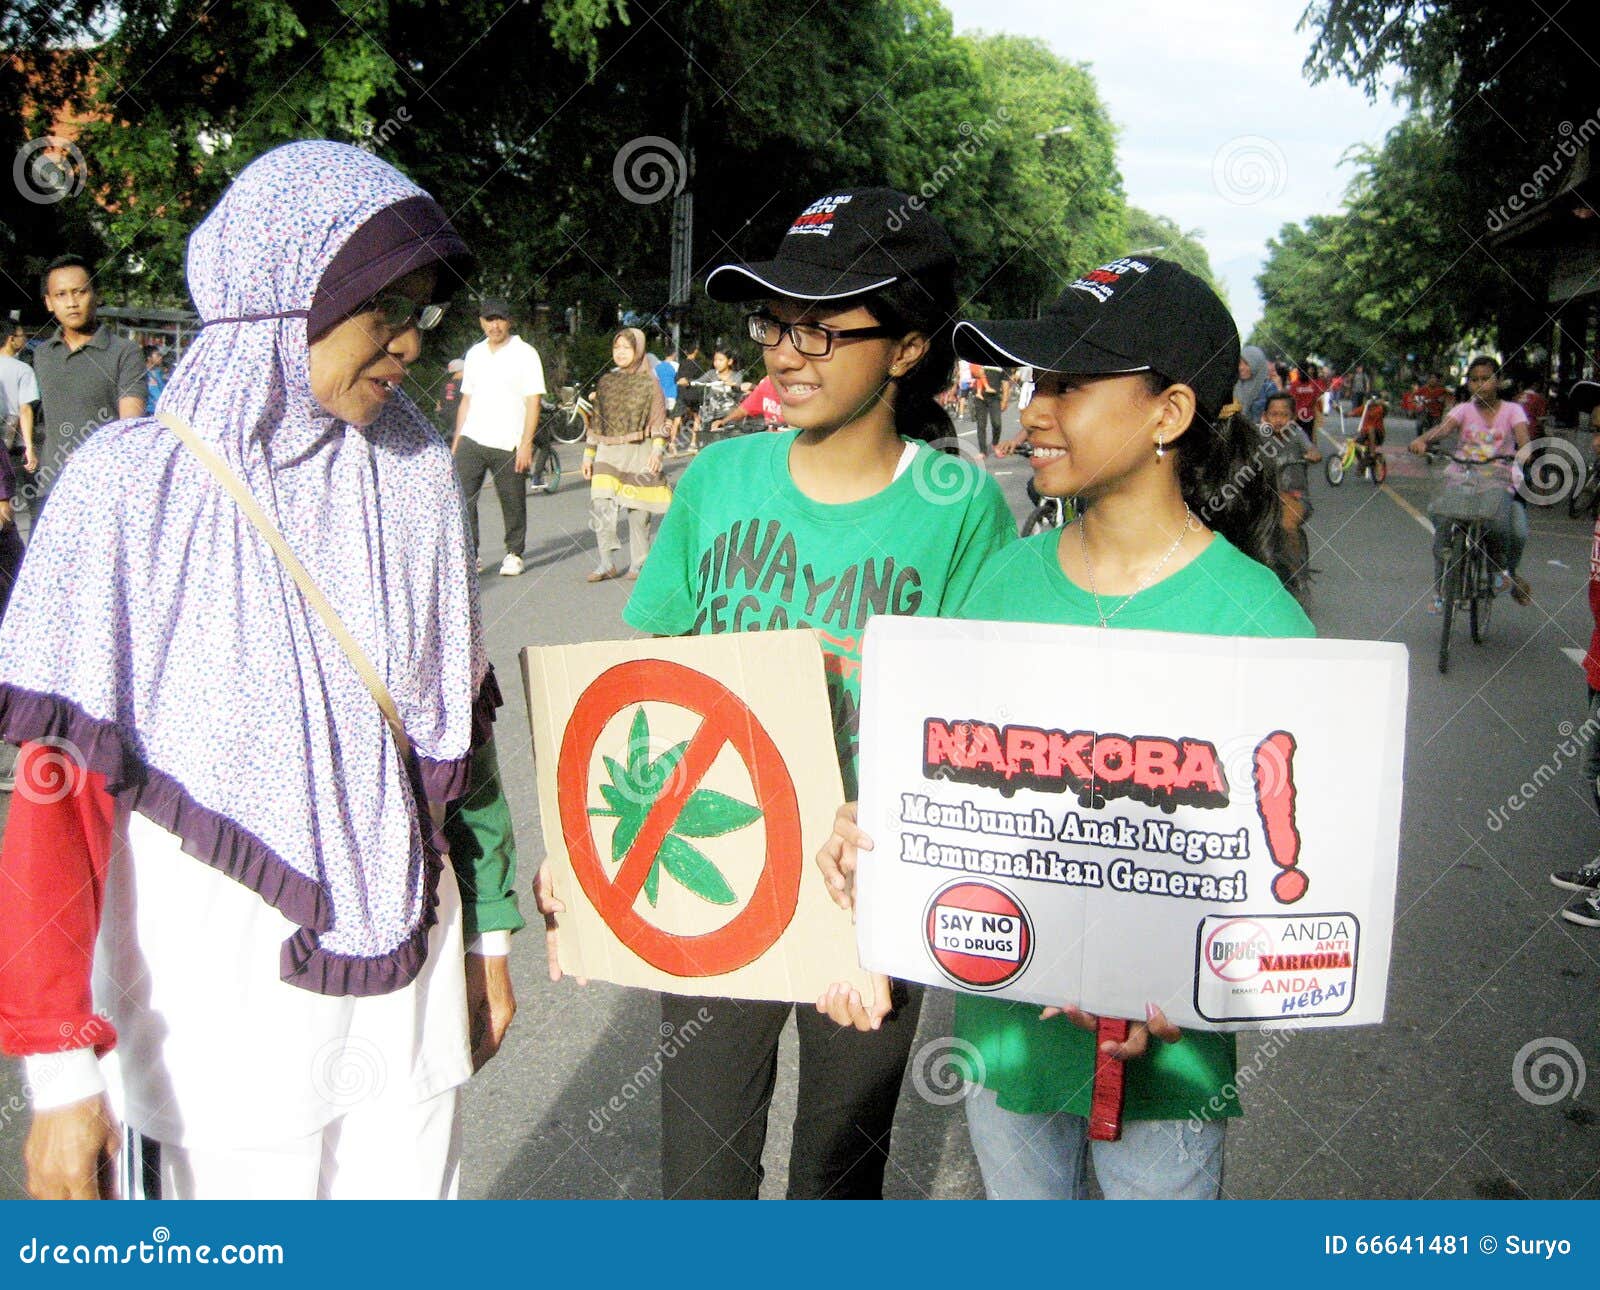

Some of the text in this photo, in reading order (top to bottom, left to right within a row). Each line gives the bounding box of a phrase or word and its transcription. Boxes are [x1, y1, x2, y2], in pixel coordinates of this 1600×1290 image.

[803, 556, 923, 630] YANG
[923, 717, 1230, 811] NARKOBA
[901, 792, 1250, 861] Membunuh Anak Negeri
[901, 832, 1247, 902] Memusnahkan Generasi
[940, 914, 1014, 934] SAY NO
[1281, 921, 1350, 942] ANDA
[943, 936, 1013, 952] TO DRUGS
[1212, 941, 1267, 961] DRUGS
[1314, 940, 1350, 951] ANTI
[1258, 951, 1352, 972] NARKOBA
[1260, 976, 1319, 994] ANDA
[1281, 981, 1347, 1013] HEBAT
